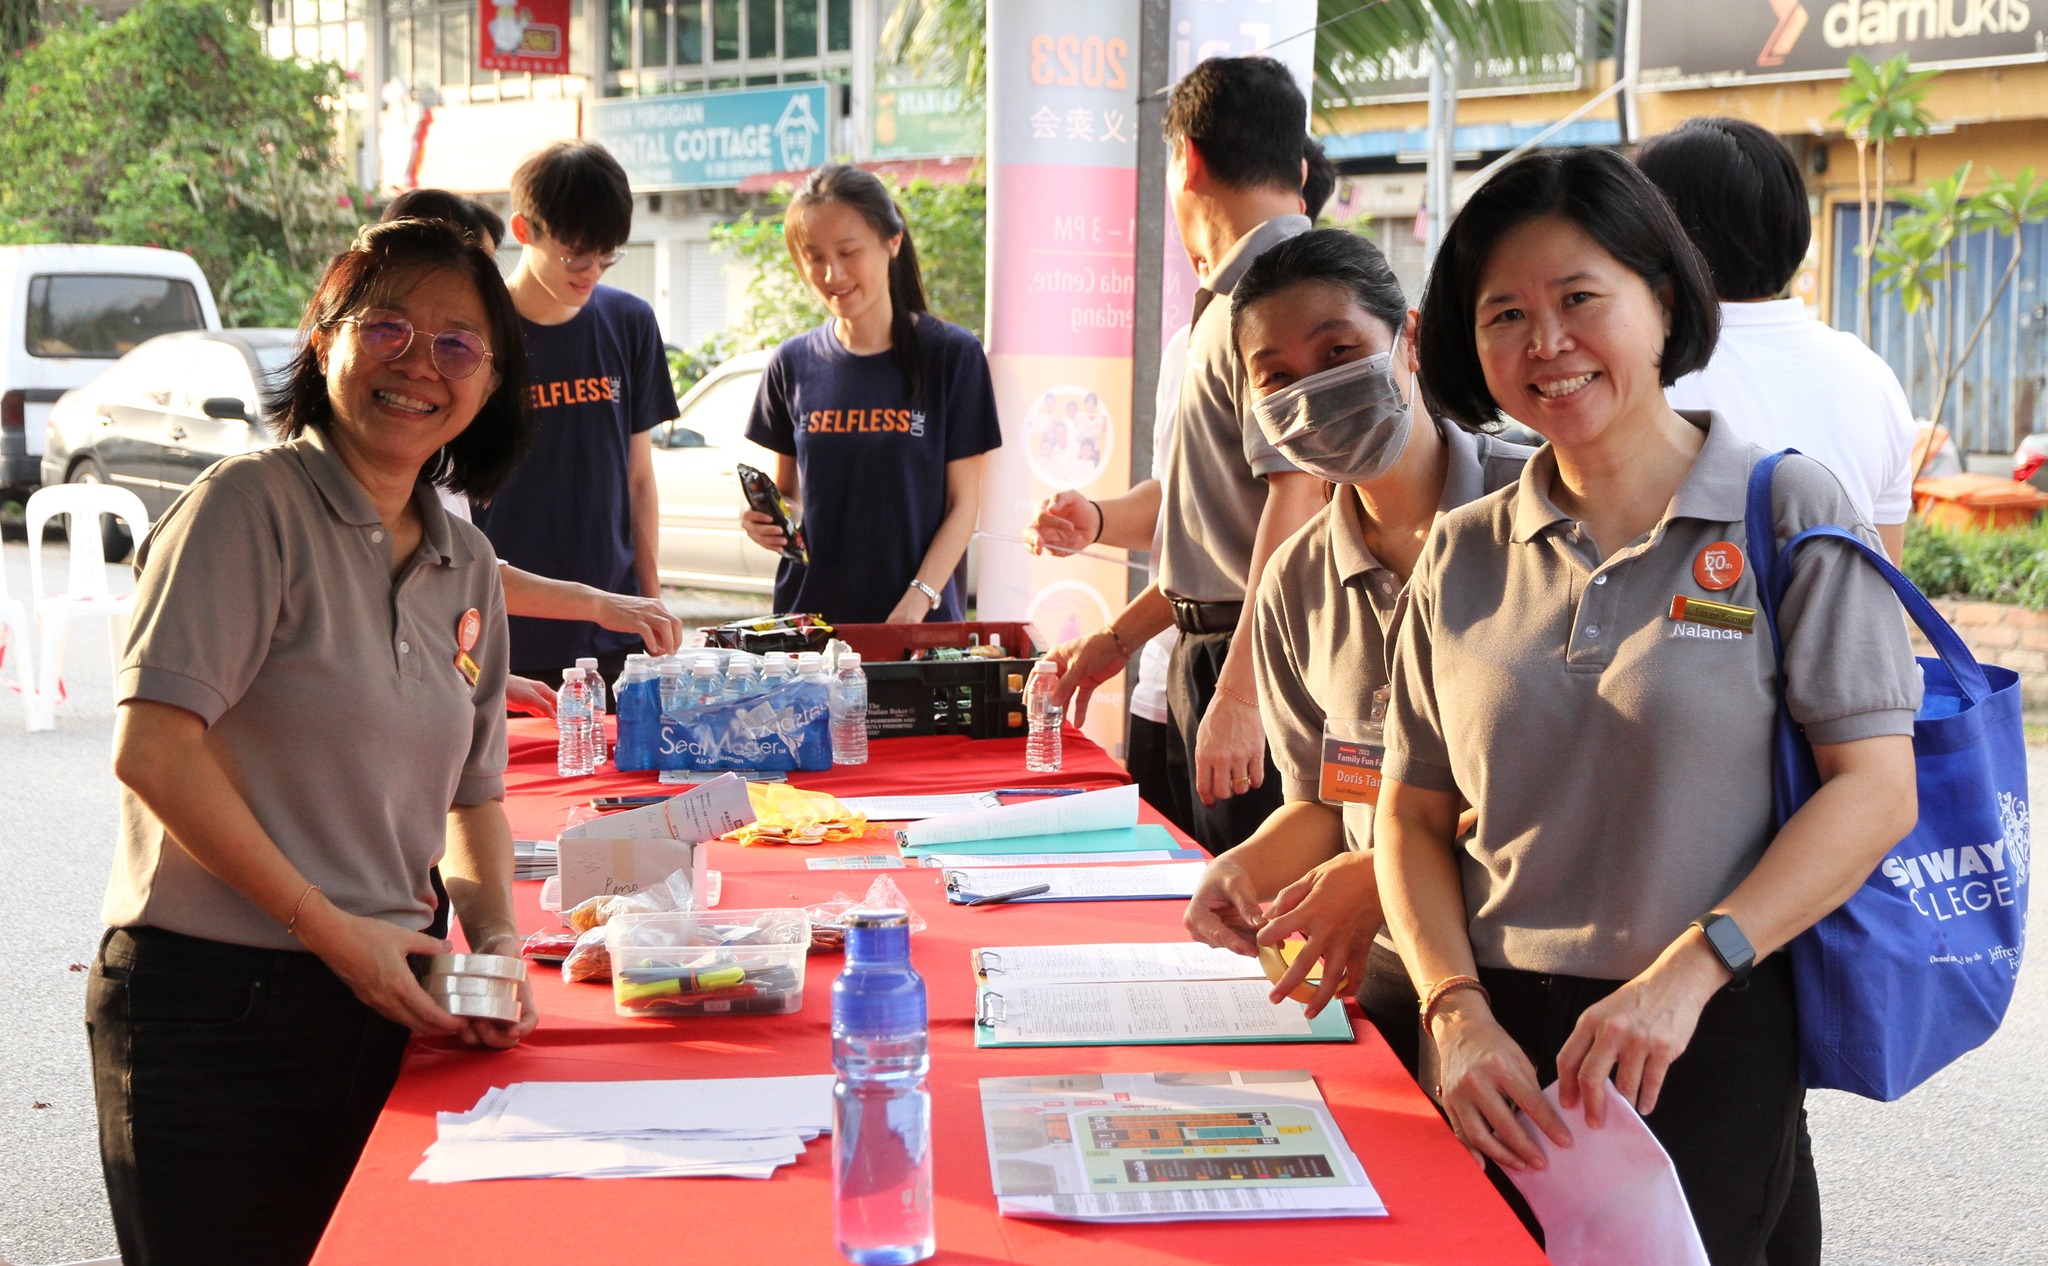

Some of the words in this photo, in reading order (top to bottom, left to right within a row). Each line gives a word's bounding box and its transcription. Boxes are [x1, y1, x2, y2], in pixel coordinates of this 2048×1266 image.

[602, 131, 672, 165] ENTAL
[674, 122, 772, 163] COTTAGE
[807, 408, 911, 433] SELFLESS
[909, 409, 926, 437] ONE
[1673, 623, 1743, 640] Nalanda
[1338, 753, 1360, 765] Family
[1361, 757, 1374, 766] Fun
[1358, 748, 1370, 756] 2023
[1337, 770, 1363, 785] Doris
[1988, 944, 2019, 965] Jeffrey
